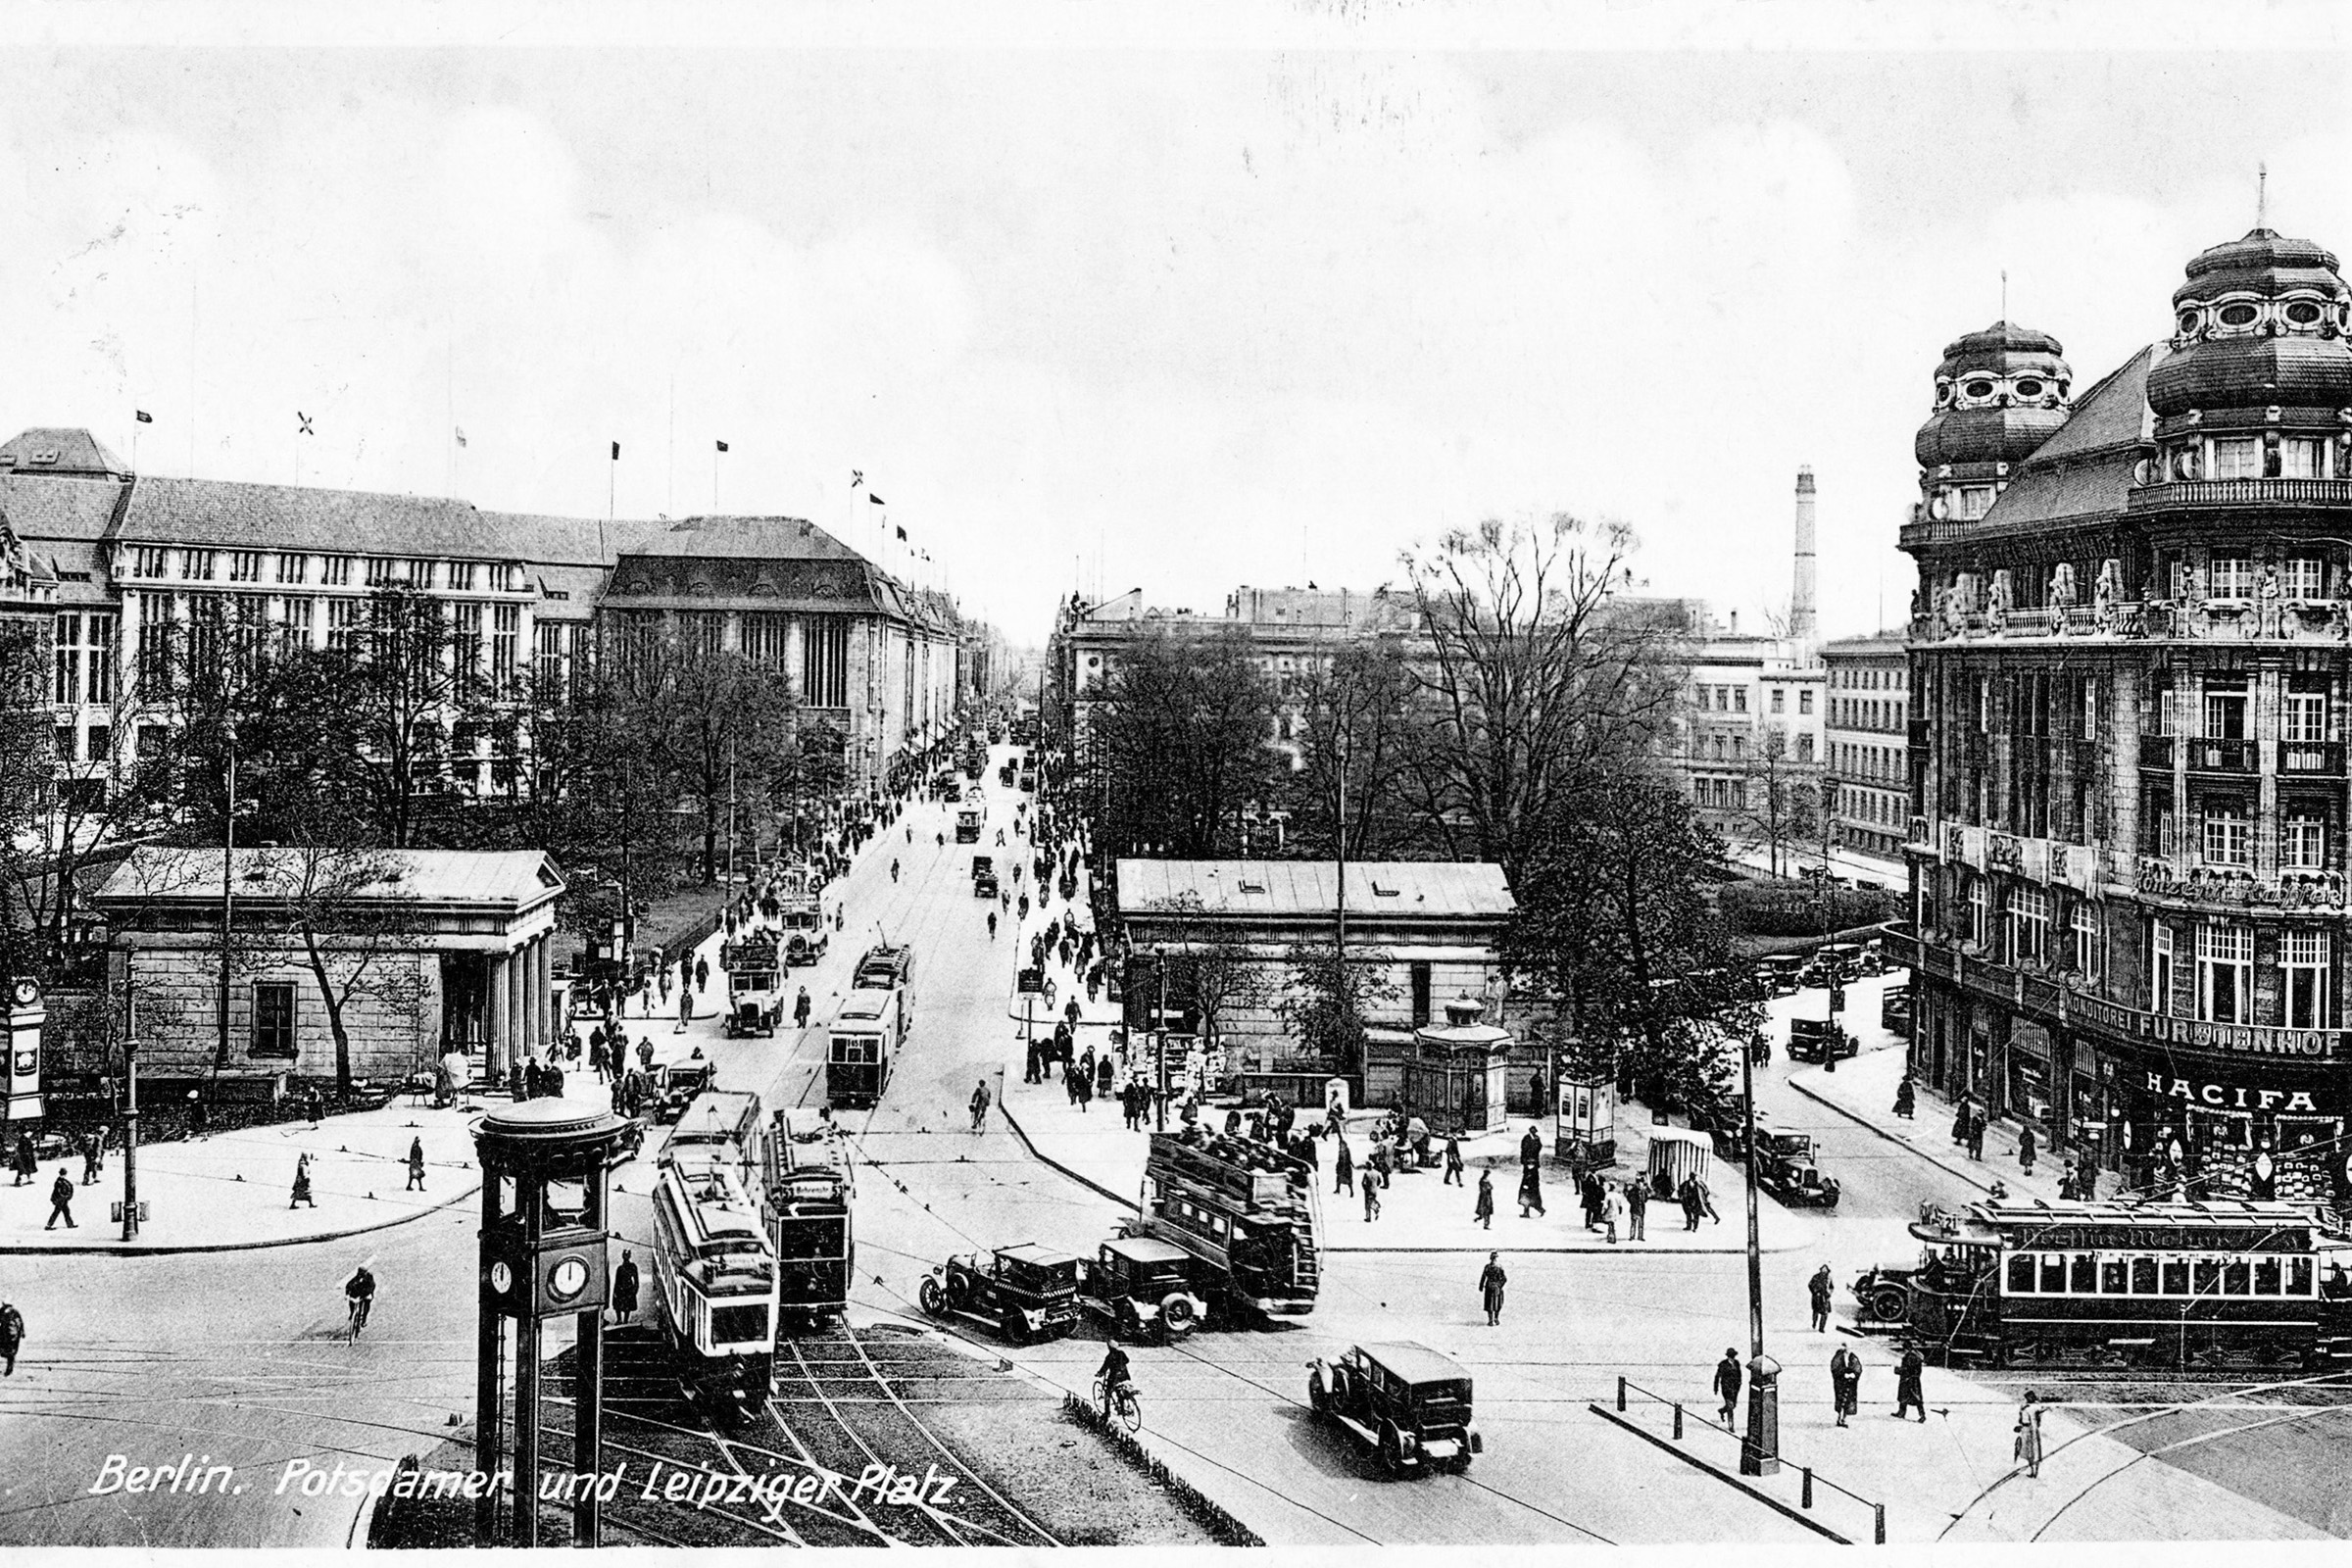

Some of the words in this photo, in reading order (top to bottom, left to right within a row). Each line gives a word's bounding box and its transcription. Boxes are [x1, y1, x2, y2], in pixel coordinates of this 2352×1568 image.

[2066, 992, 2132, 1030] KONDITOREI
[2147, 1071, 2317, 1111] HACIFA
[832, 1185, 843, 1197] 53
